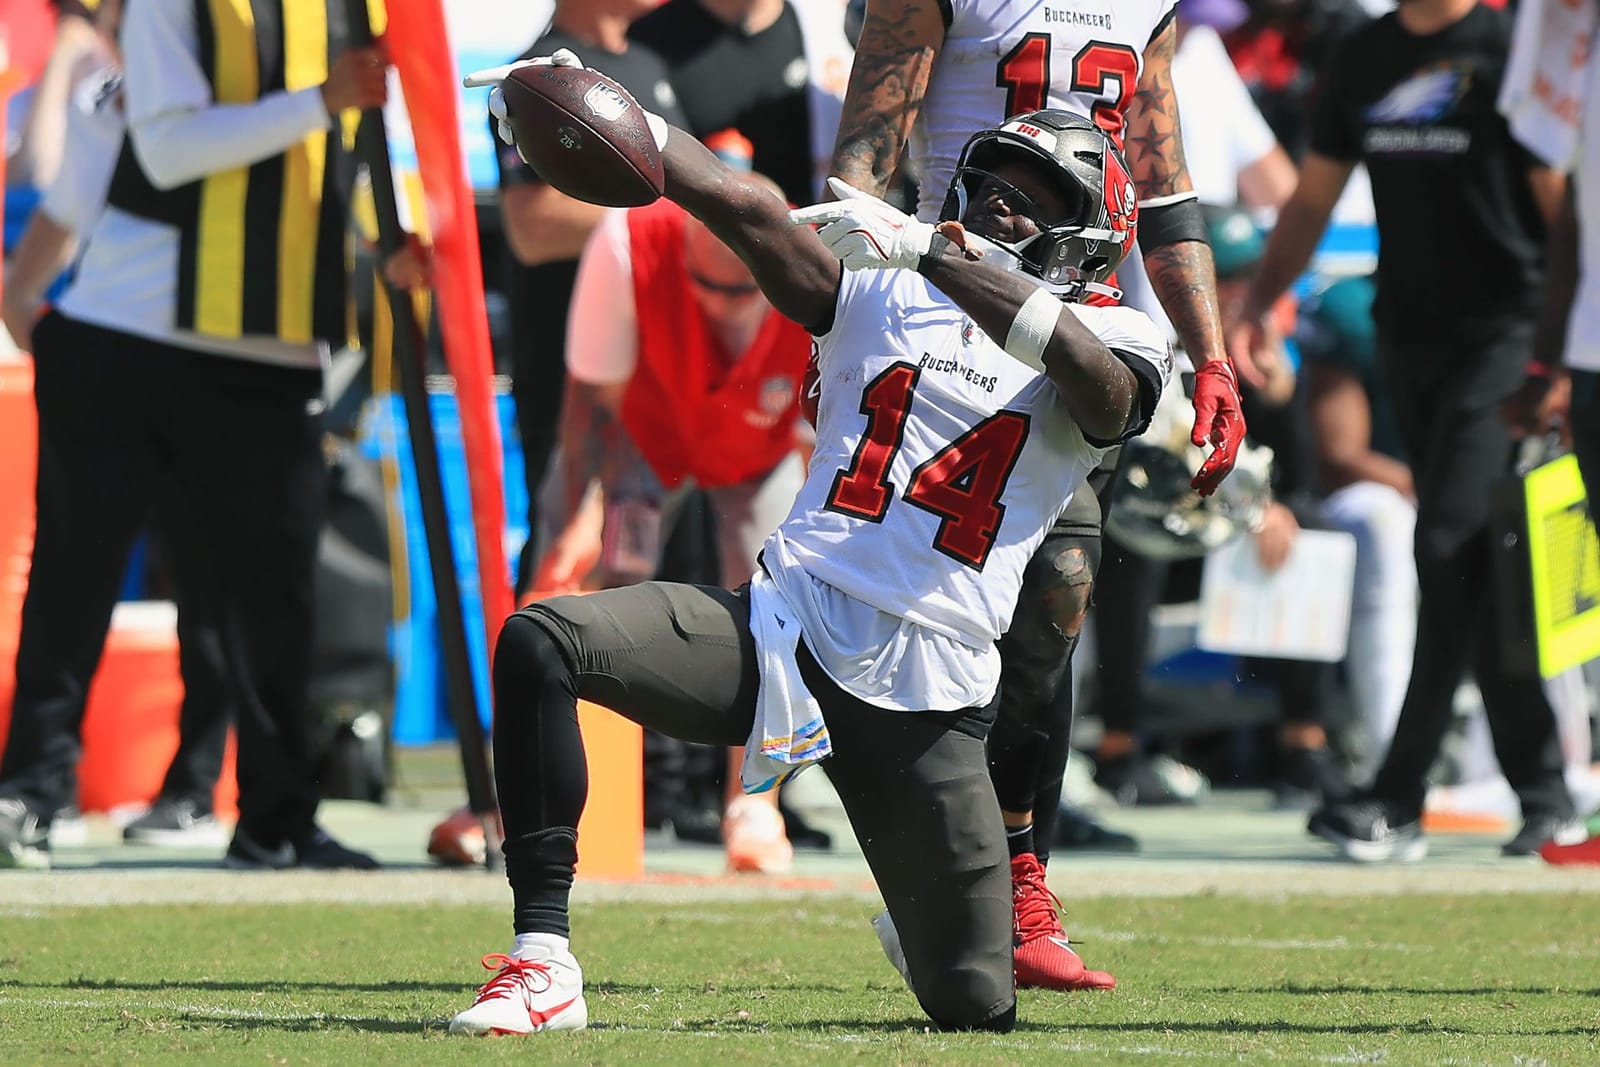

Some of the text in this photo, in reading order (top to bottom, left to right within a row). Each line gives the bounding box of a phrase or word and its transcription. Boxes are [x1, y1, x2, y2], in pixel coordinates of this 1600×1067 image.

[1044, 7, 1112, 30] BUCCANEERS
[560, 134, 575, 149] 215
[918, 352, 998, 393] BUCCANEERS
[823, 361, 1031, 573] 14
